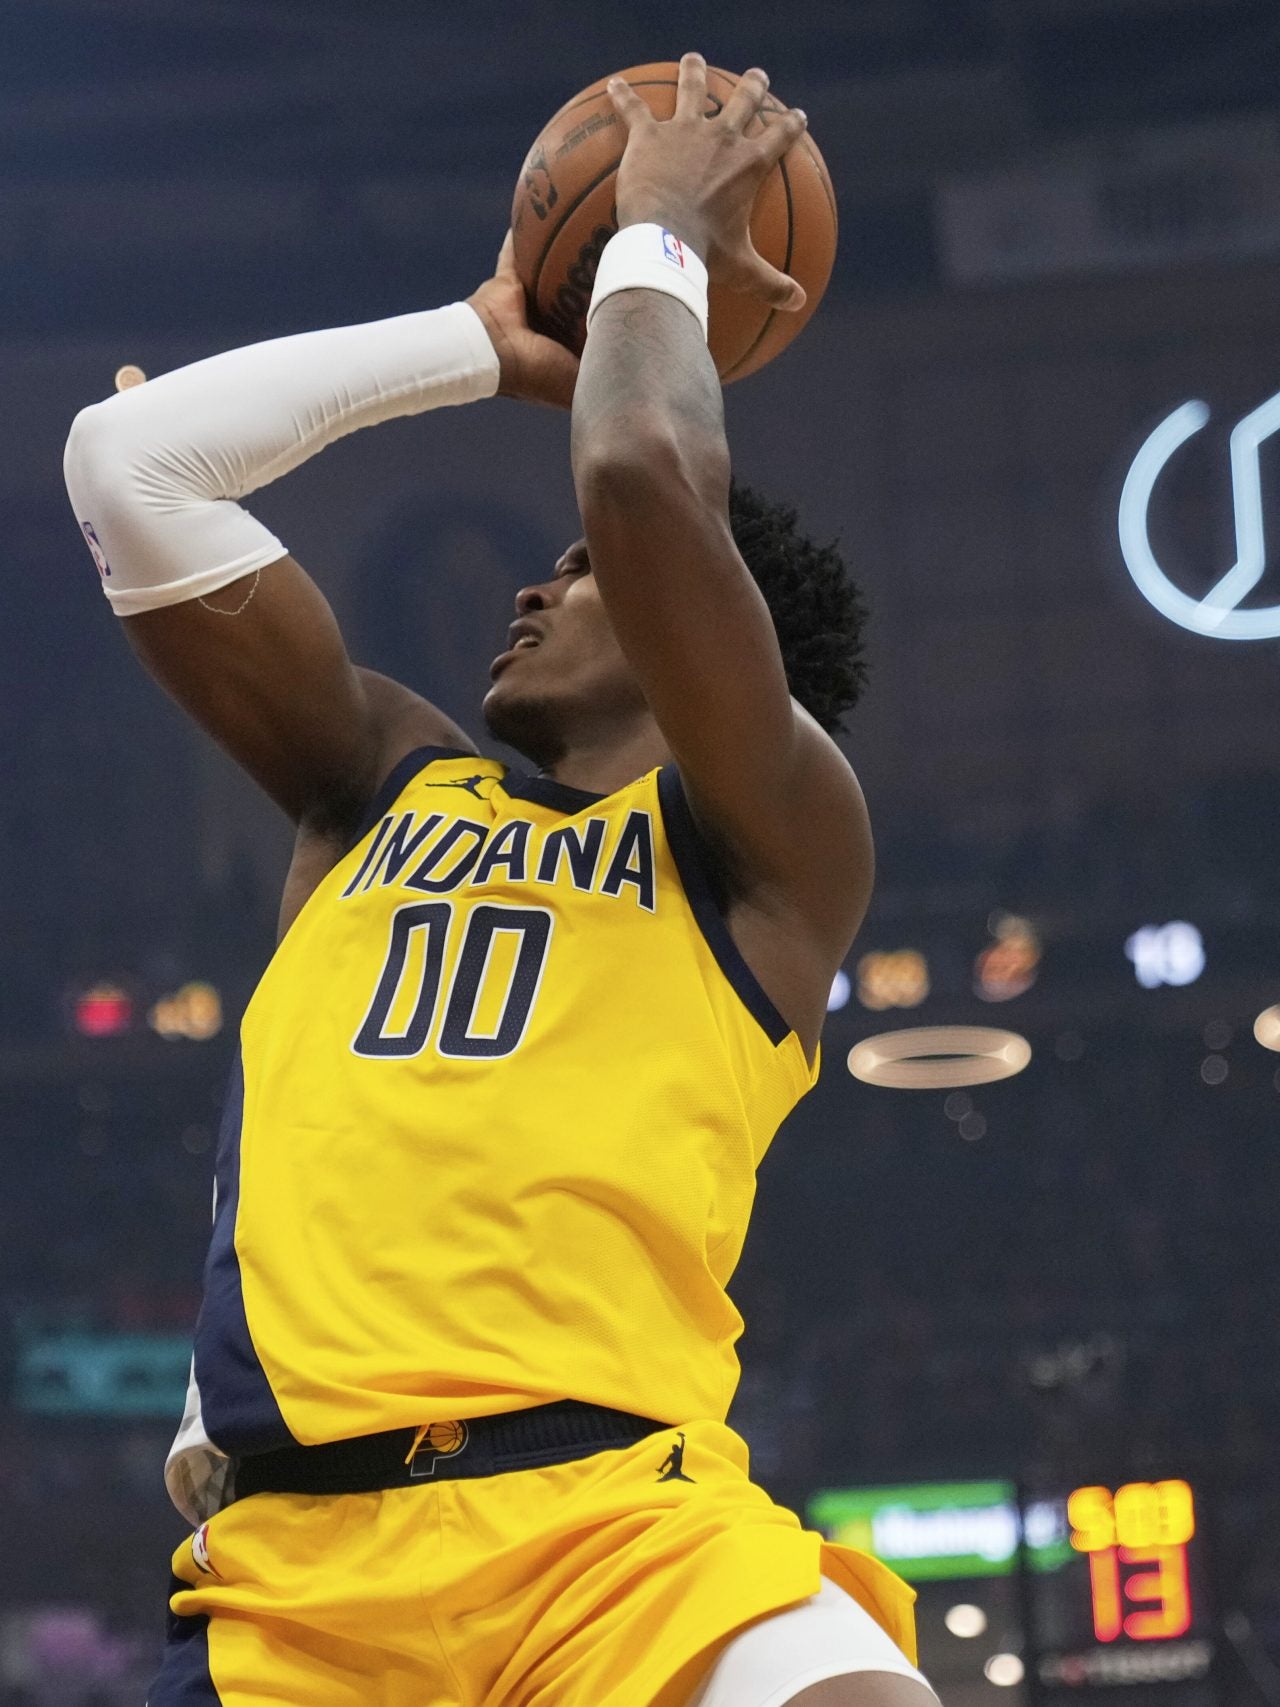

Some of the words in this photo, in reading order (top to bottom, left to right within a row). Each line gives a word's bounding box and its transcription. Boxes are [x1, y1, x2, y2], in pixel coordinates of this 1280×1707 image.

[338, 807, 656, 914] INDANA
[349, 899, 555, 1060] 00
[1089, 1545, 1192, 1642] 13
